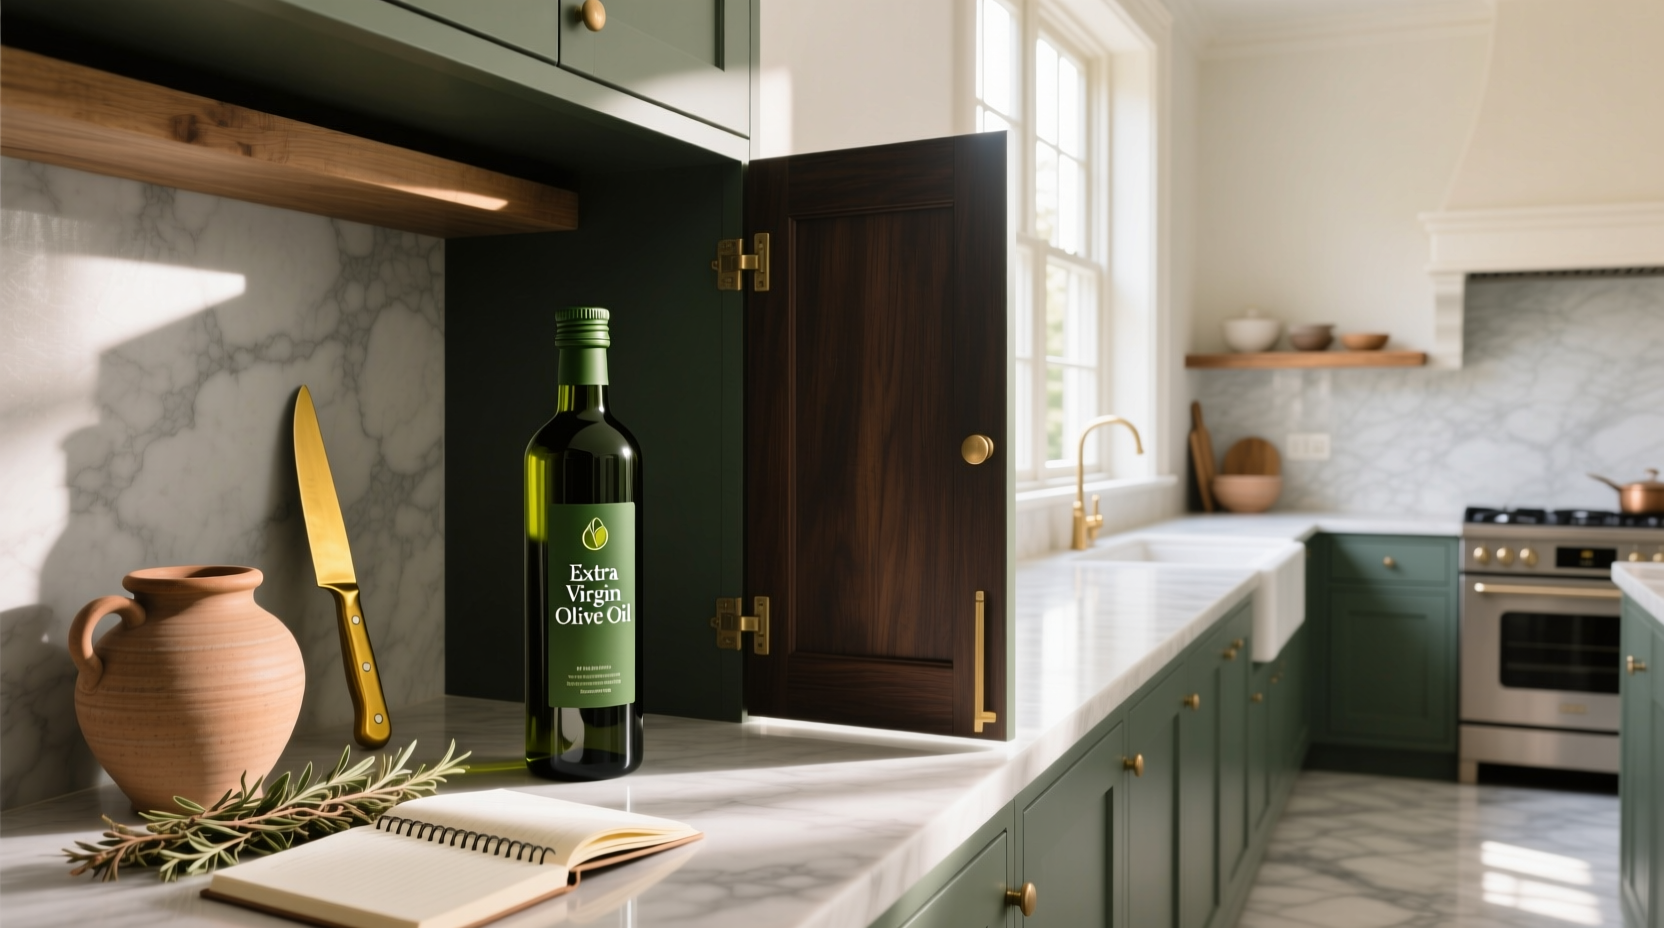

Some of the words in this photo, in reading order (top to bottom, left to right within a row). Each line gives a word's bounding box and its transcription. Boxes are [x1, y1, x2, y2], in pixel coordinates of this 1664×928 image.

[569, 564, 619, 581] Extra
[565, 584, 621, 608] Virgin
[555, 606, 604, 625] Olive
[606, 603, 632, 624] Oil
